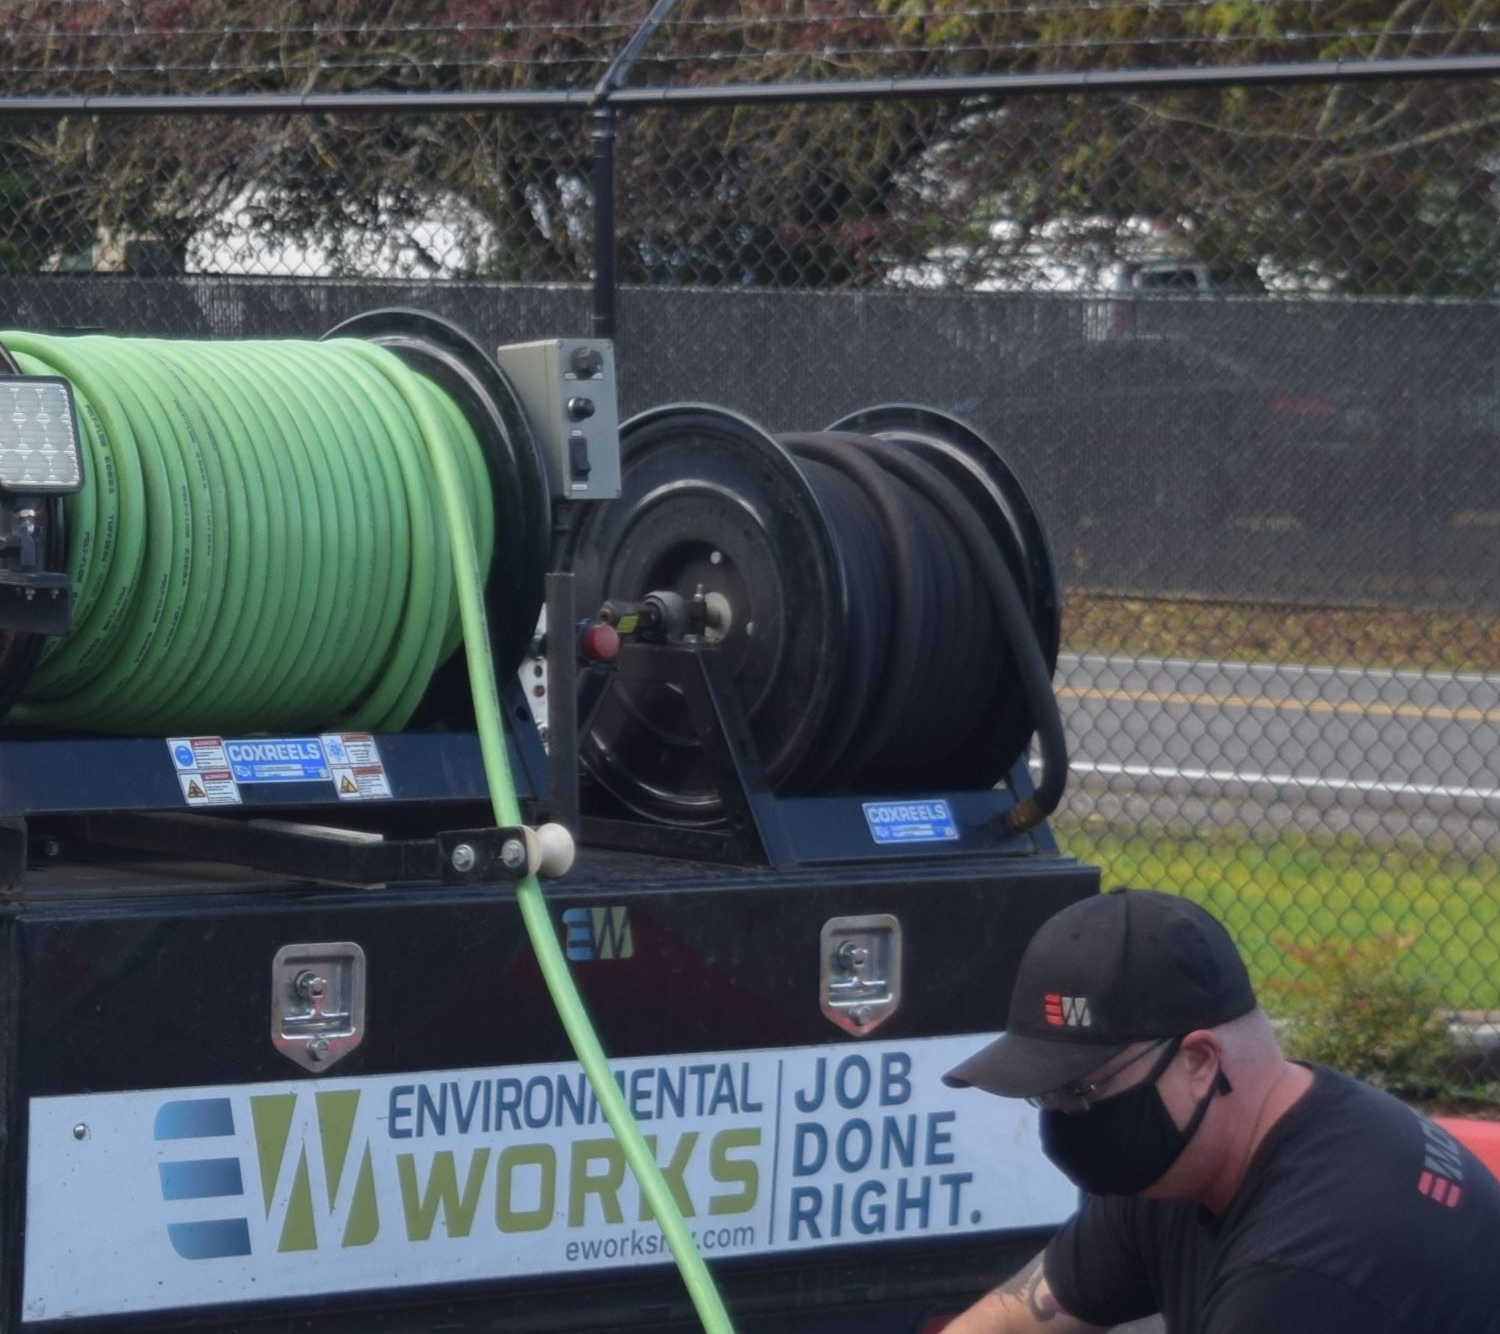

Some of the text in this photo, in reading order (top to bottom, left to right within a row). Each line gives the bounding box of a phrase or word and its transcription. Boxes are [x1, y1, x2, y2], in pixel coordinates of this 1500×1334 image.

[229, 742, 322, 763] COXREELS
[794, 1051, 913, 1114] JOB
[791, 1110, 957, 1178] DONE
[395, 1126, 763, 1243] WORKS
[787, 1171, 983, 1242] RIGHT.
[565, 1225, 755, 1262] eworks.com
